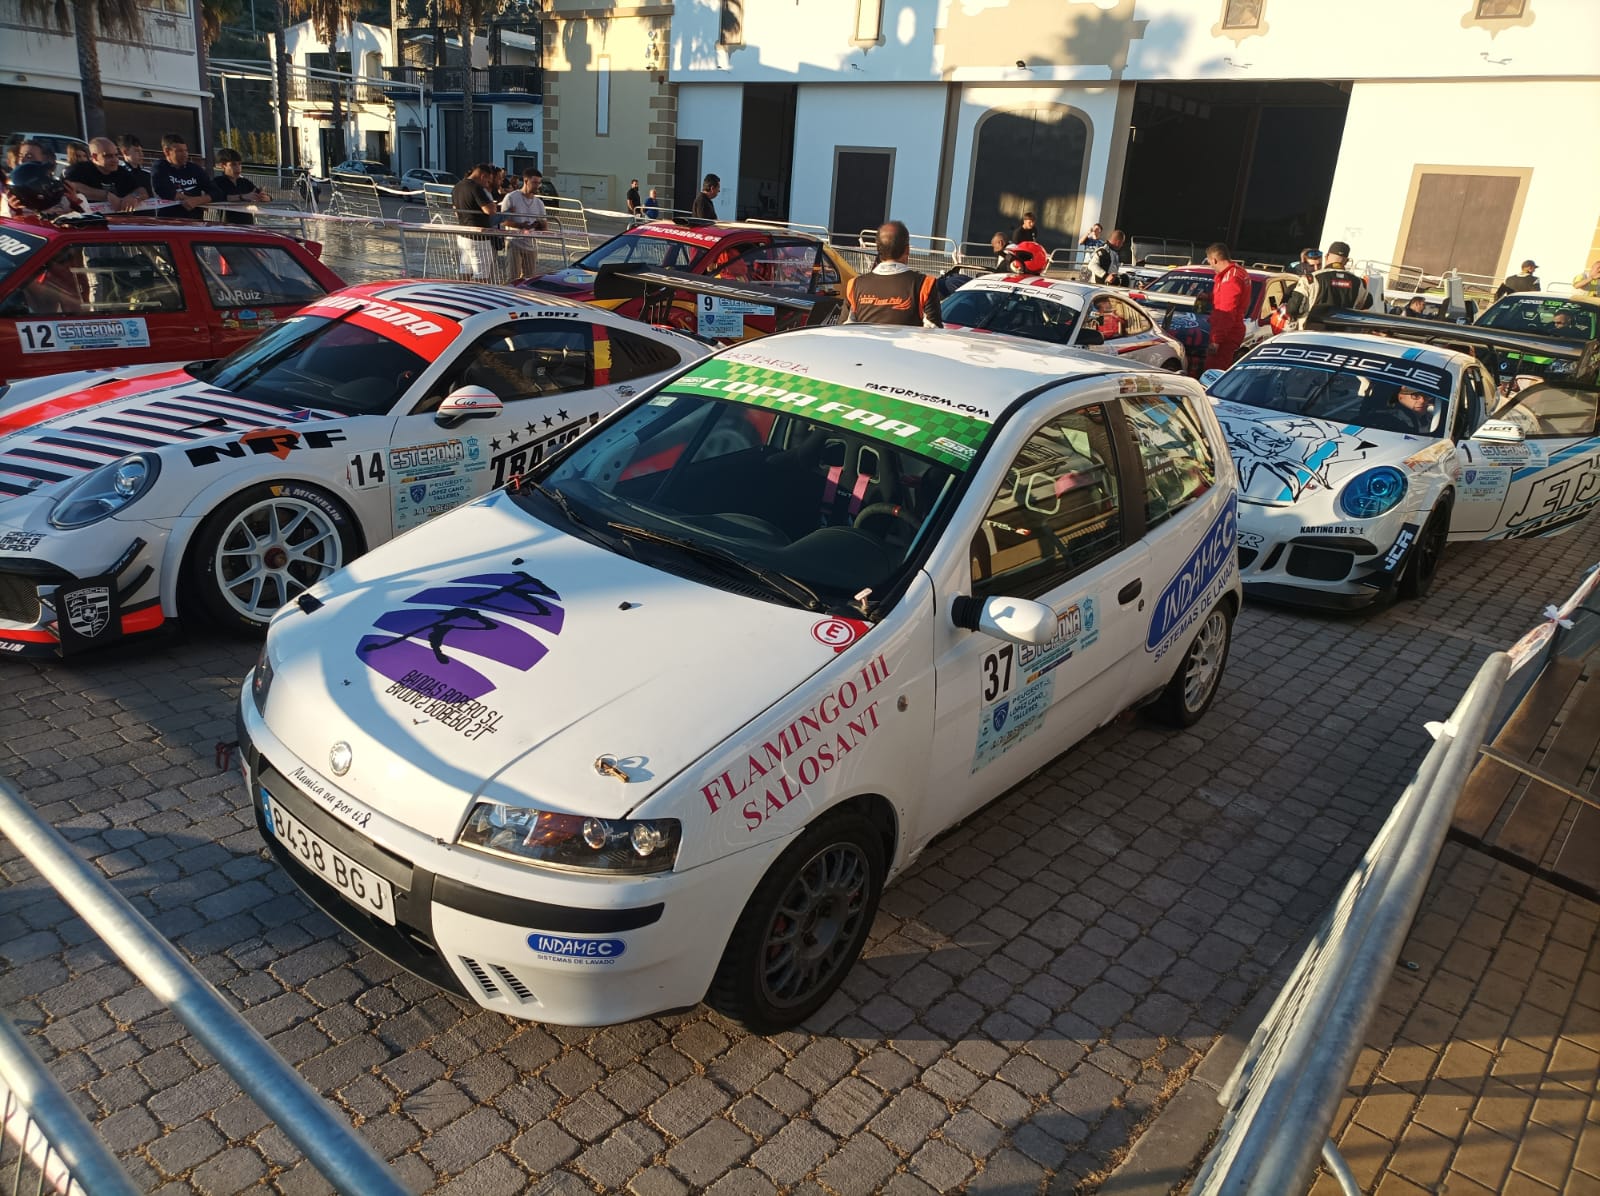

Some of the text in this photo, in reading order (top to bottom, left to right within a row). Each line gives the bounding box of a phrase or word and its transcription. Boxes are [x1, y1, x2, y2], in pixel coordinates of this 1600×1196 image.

[704, 297, 713, 311] 9
[21, 325, 55, 349] 12
[57, 324, 125, 339] ESTEPONA
[1257, 347, 1442, 384] PORSCHE
[700, 379, 921, 438] COPA FAA
[865, 382, 990, 418] FACTORYGSM.COM
[185, 429, 347, 468] NRF
[389, 442, 465, 470] ESTEPONA
[1461, 443, 1473, 464] 1
[351, 452, 385, 487] 14
[293, 488, 342, 522] MICHELIN
[1300, 526, 1333, 534] KARTING
[1384, 530, 1414, 572] JCR
[1162, 511, 1233, 633] INDAMEC
[1154, 554, 1236, 664] SISTEMAS DE LAVADO
[826, 623, 844, 639] E
[984, 643, 1014, 702] 37
[401, 669, 447, 698] BANDAS
[441, 688, 488, 720] ROBERO
[700, 654, 891, 815] FLAMINGO III
[743, 701, 880, 832] SALOSANT
[323, 791, 336, 803] va
[332, 800, 353, 815] por
[273, 808, 326, 872] 8438
[537, 954, 573, 965] SISTEMAS
[538, 937, 613, 955] INDAMEC
